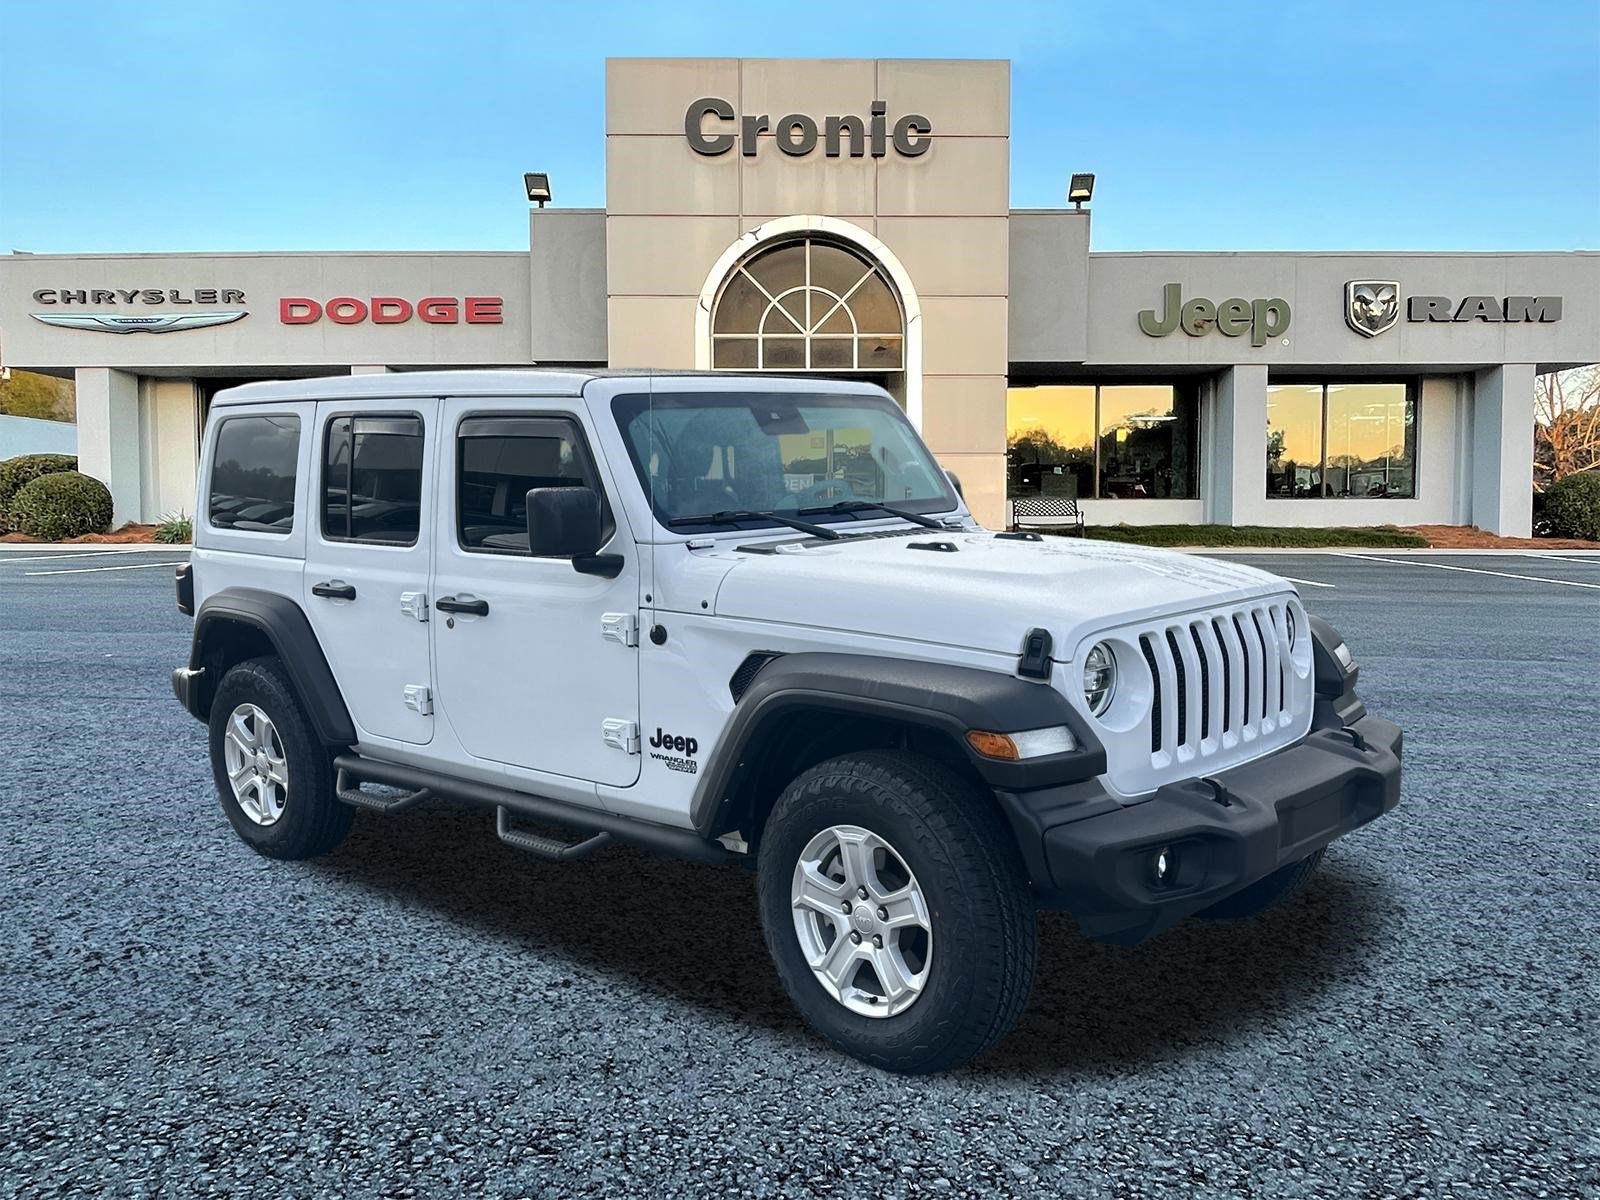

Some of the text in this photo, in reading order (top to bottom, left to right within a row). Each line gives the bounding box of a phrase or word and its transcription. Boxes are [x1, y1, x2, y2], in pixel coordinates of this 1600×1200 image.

[685, 97, 932, 157] Cronic
[32, 289, 246, 304] CHRYSLER
[279, 297, 503, 324] DODGE
[1407, 296, 1563, 322] RAM
[1138, 283, 1291, 347] Jeep
[649, 728, 698, 757] Jeep
